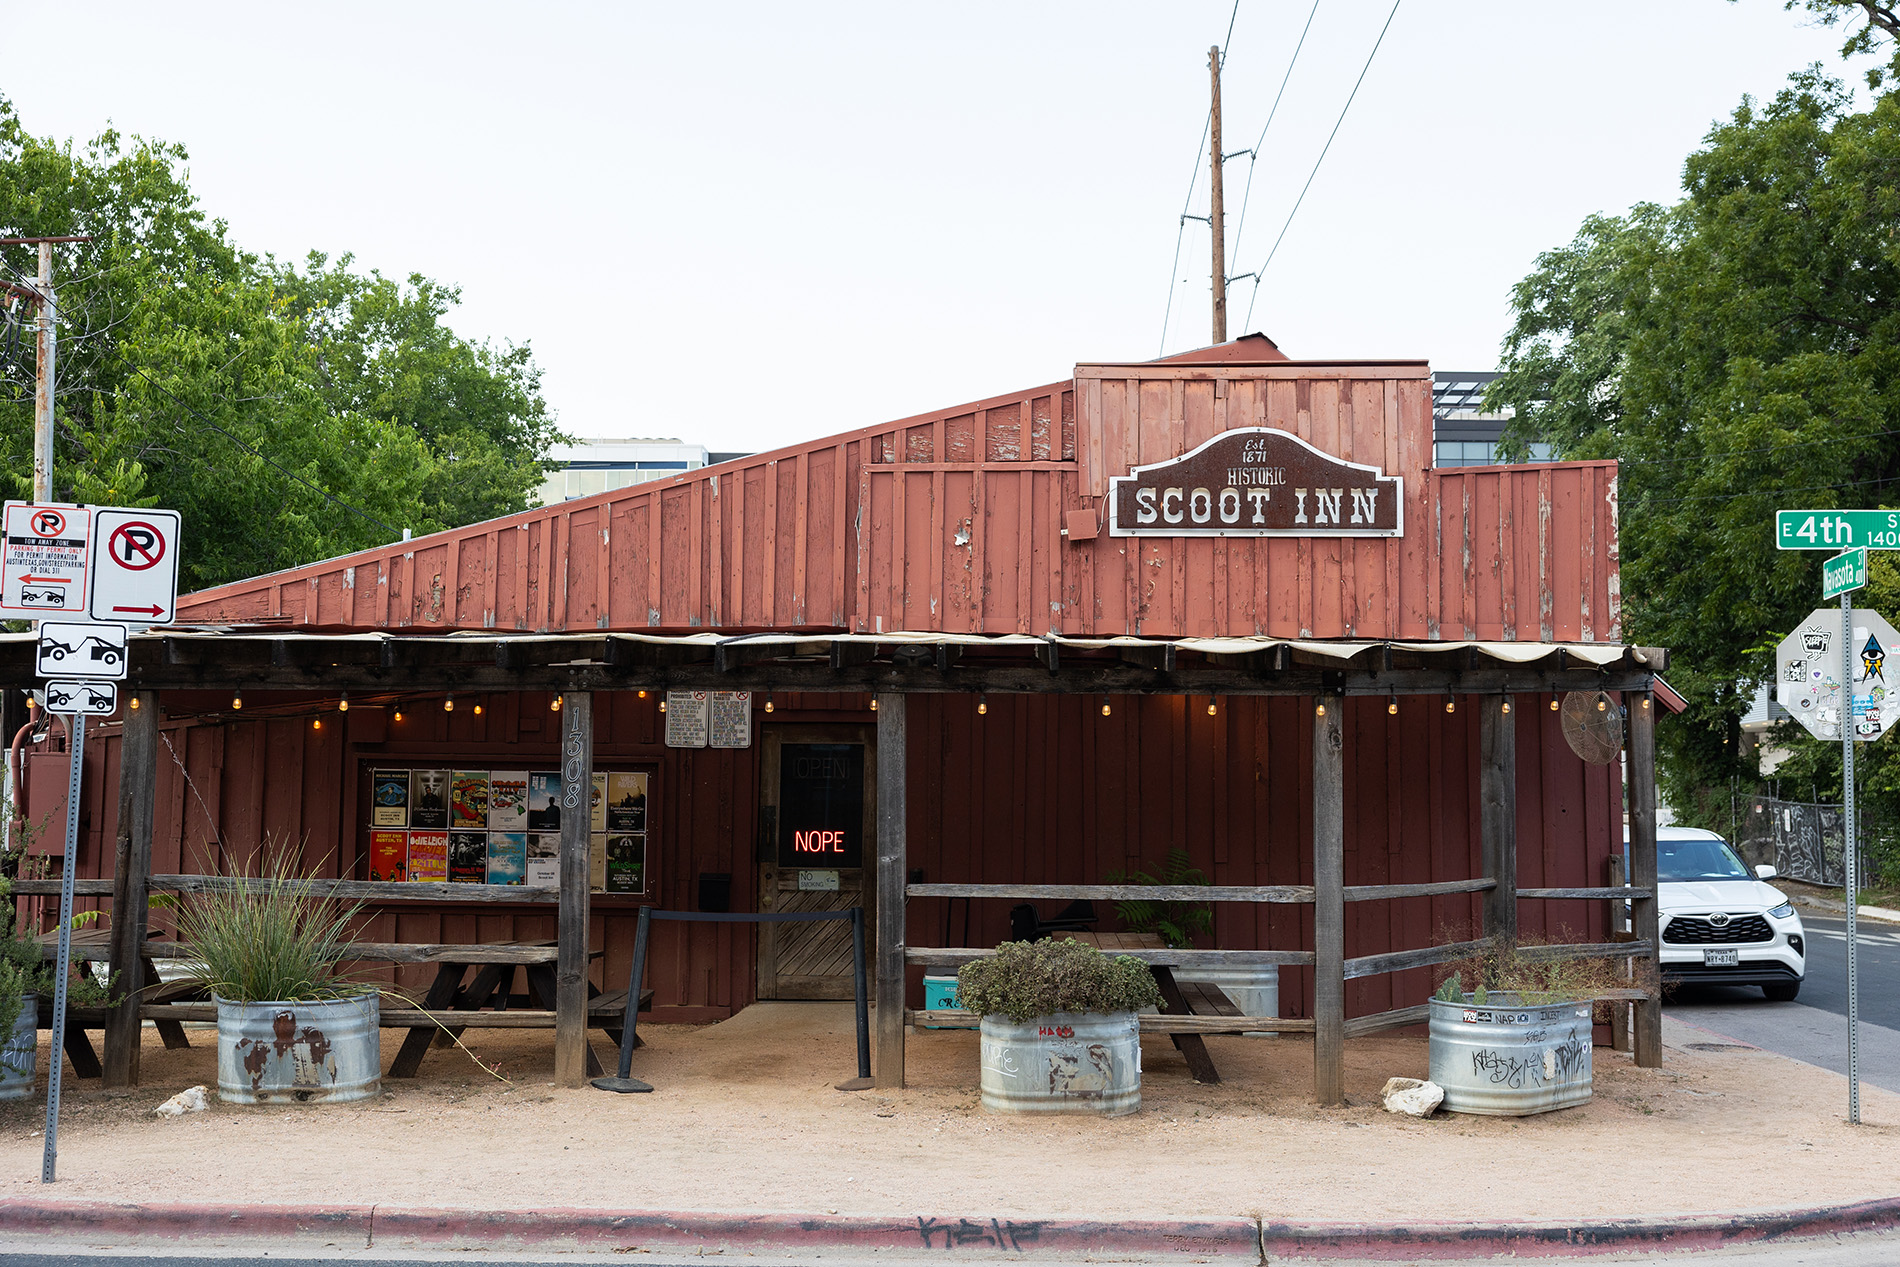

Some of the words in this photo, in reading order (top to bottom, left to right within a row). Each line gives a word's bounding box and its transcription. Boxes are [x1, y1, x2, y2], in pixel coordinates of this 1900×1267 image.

[1242, 451, 1267, 462] 1871
[1227, 467, 1286, 486] HISTORIC
[1136, 487, 1270, 524] SCOOT
[1295, 488, 1378, 524] INN
[1782, 522, 1792, 536] E
[1796, 516, 1852, 544] 4th
[1888, 514, 1900, 528] S
[564, 706, 583, 809] 1308
[796, 757, 846, 778] OPEN
[794, 830, 845, 853] NOPE
[410, 858, 426, 867] 2024
[801, 873, 813, 881] NO
[1495, 1014, 1515, 1024] NAP
